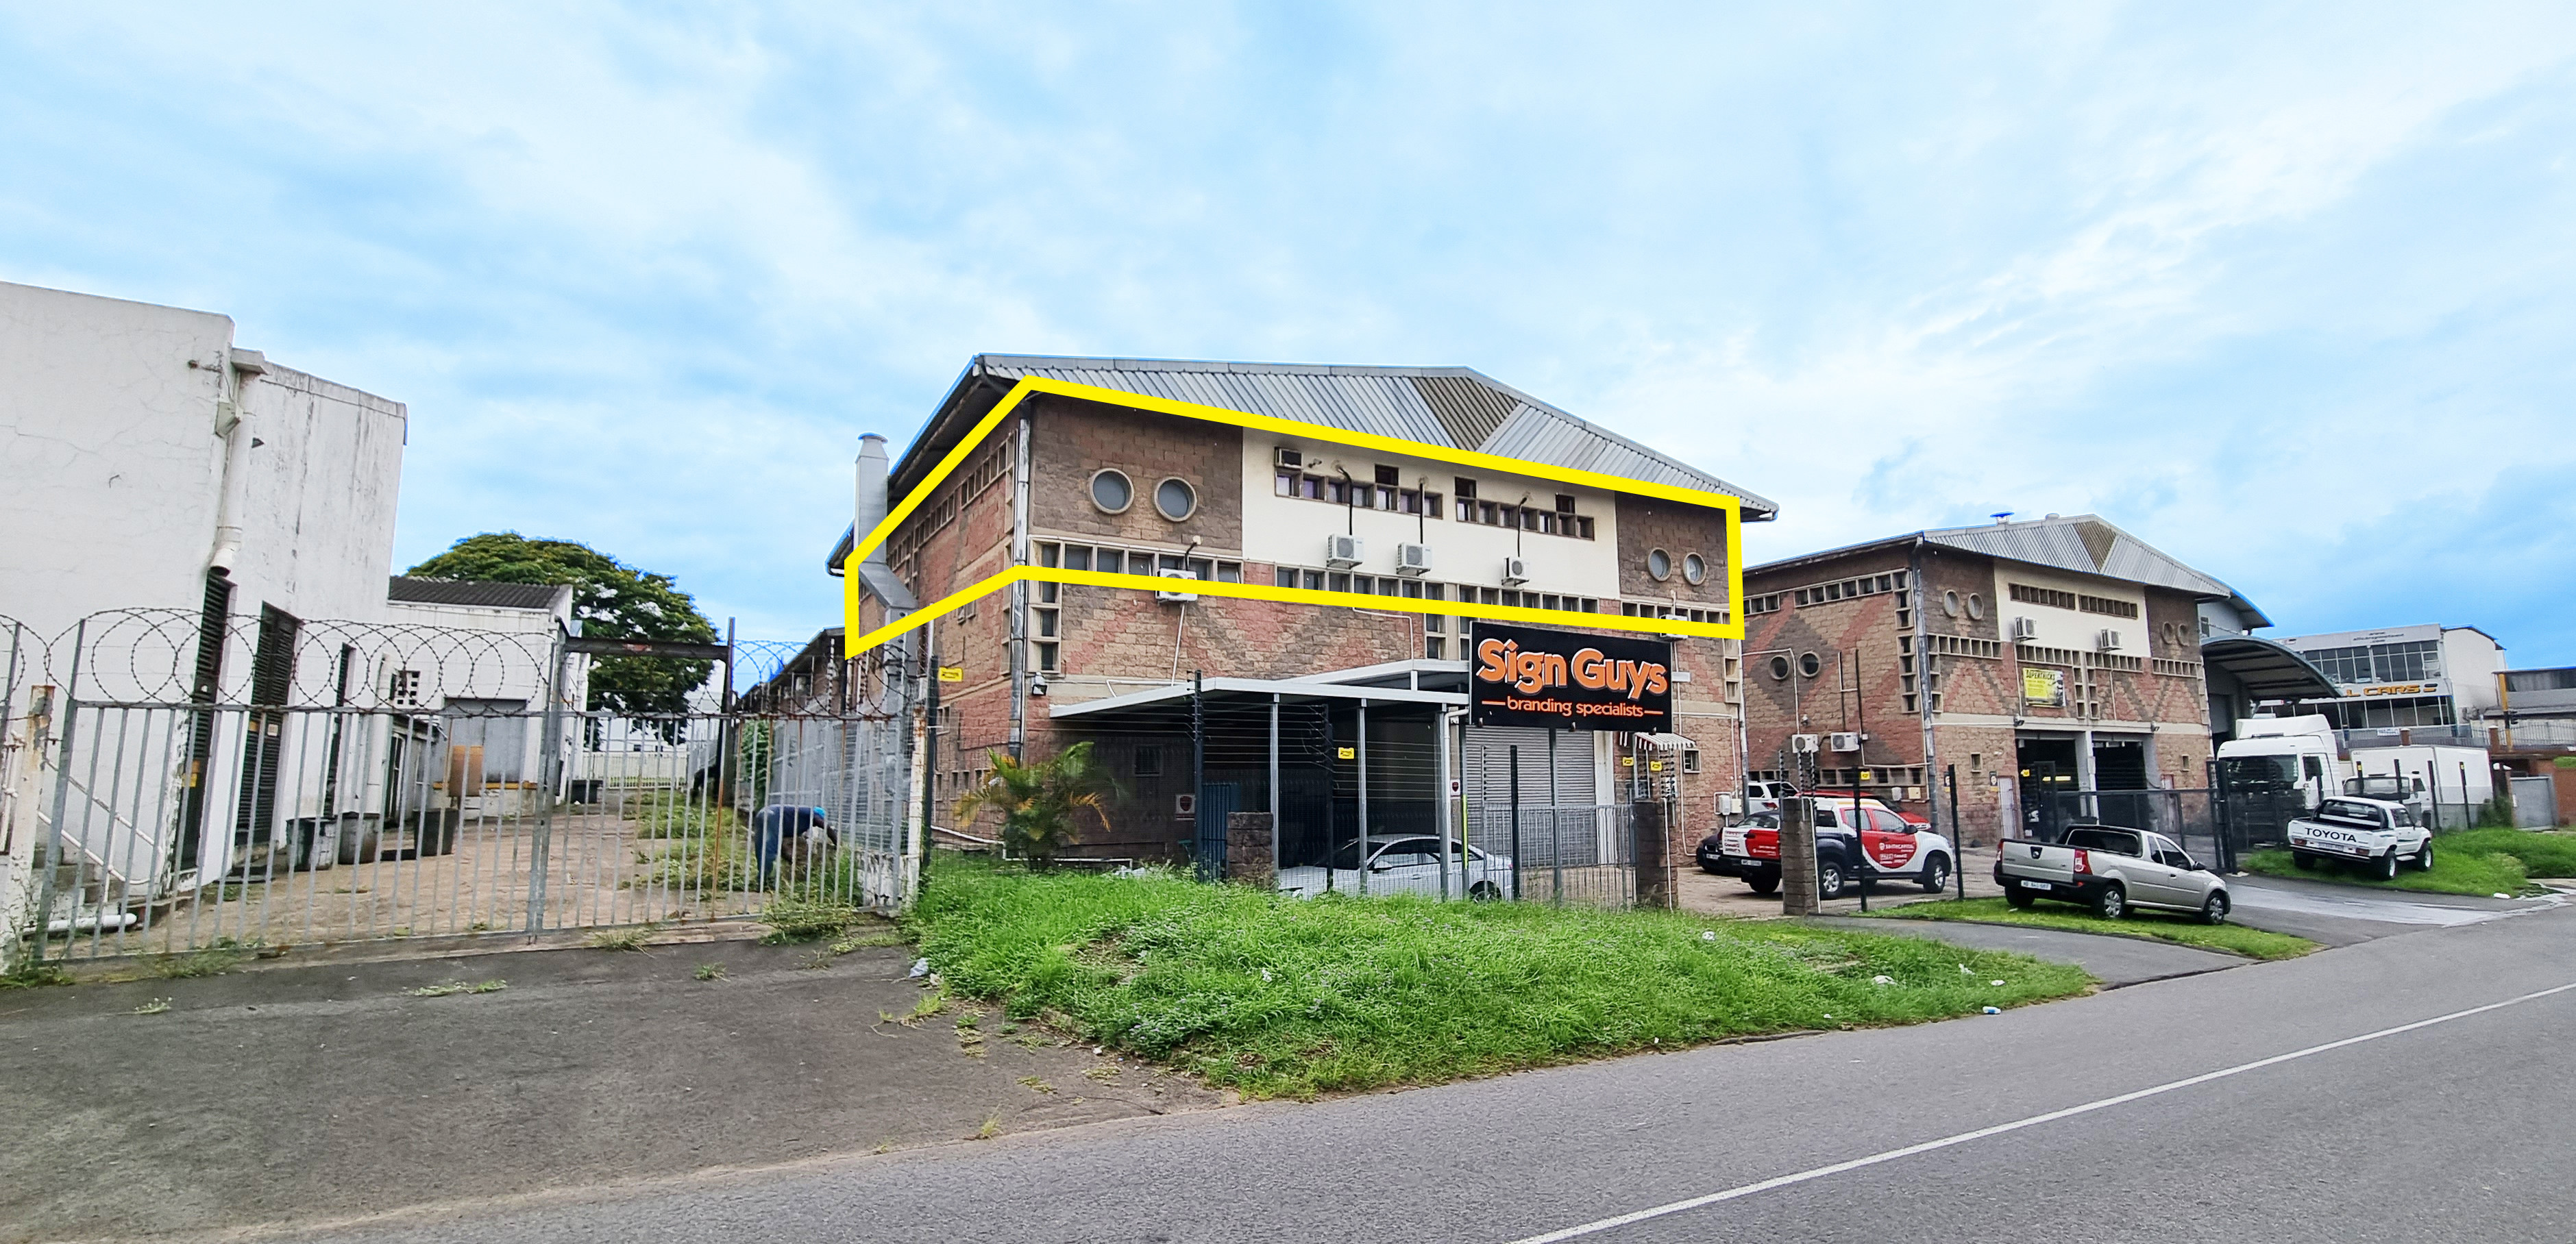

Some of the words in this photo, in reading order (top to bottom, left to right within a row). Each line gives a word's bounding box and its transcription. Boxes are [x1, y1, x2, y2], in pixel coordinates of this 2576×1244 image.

[1476, 638, 1567, 695] Sign
[1571, 647, 1667, 701] Guys
[2364, 684, 2420, 696] CARS
[1507, 695, 1572, 717] branding
[1575, 701, 1644, 717] specialists
[2305, 827, 2357, 843] TOYOTA
